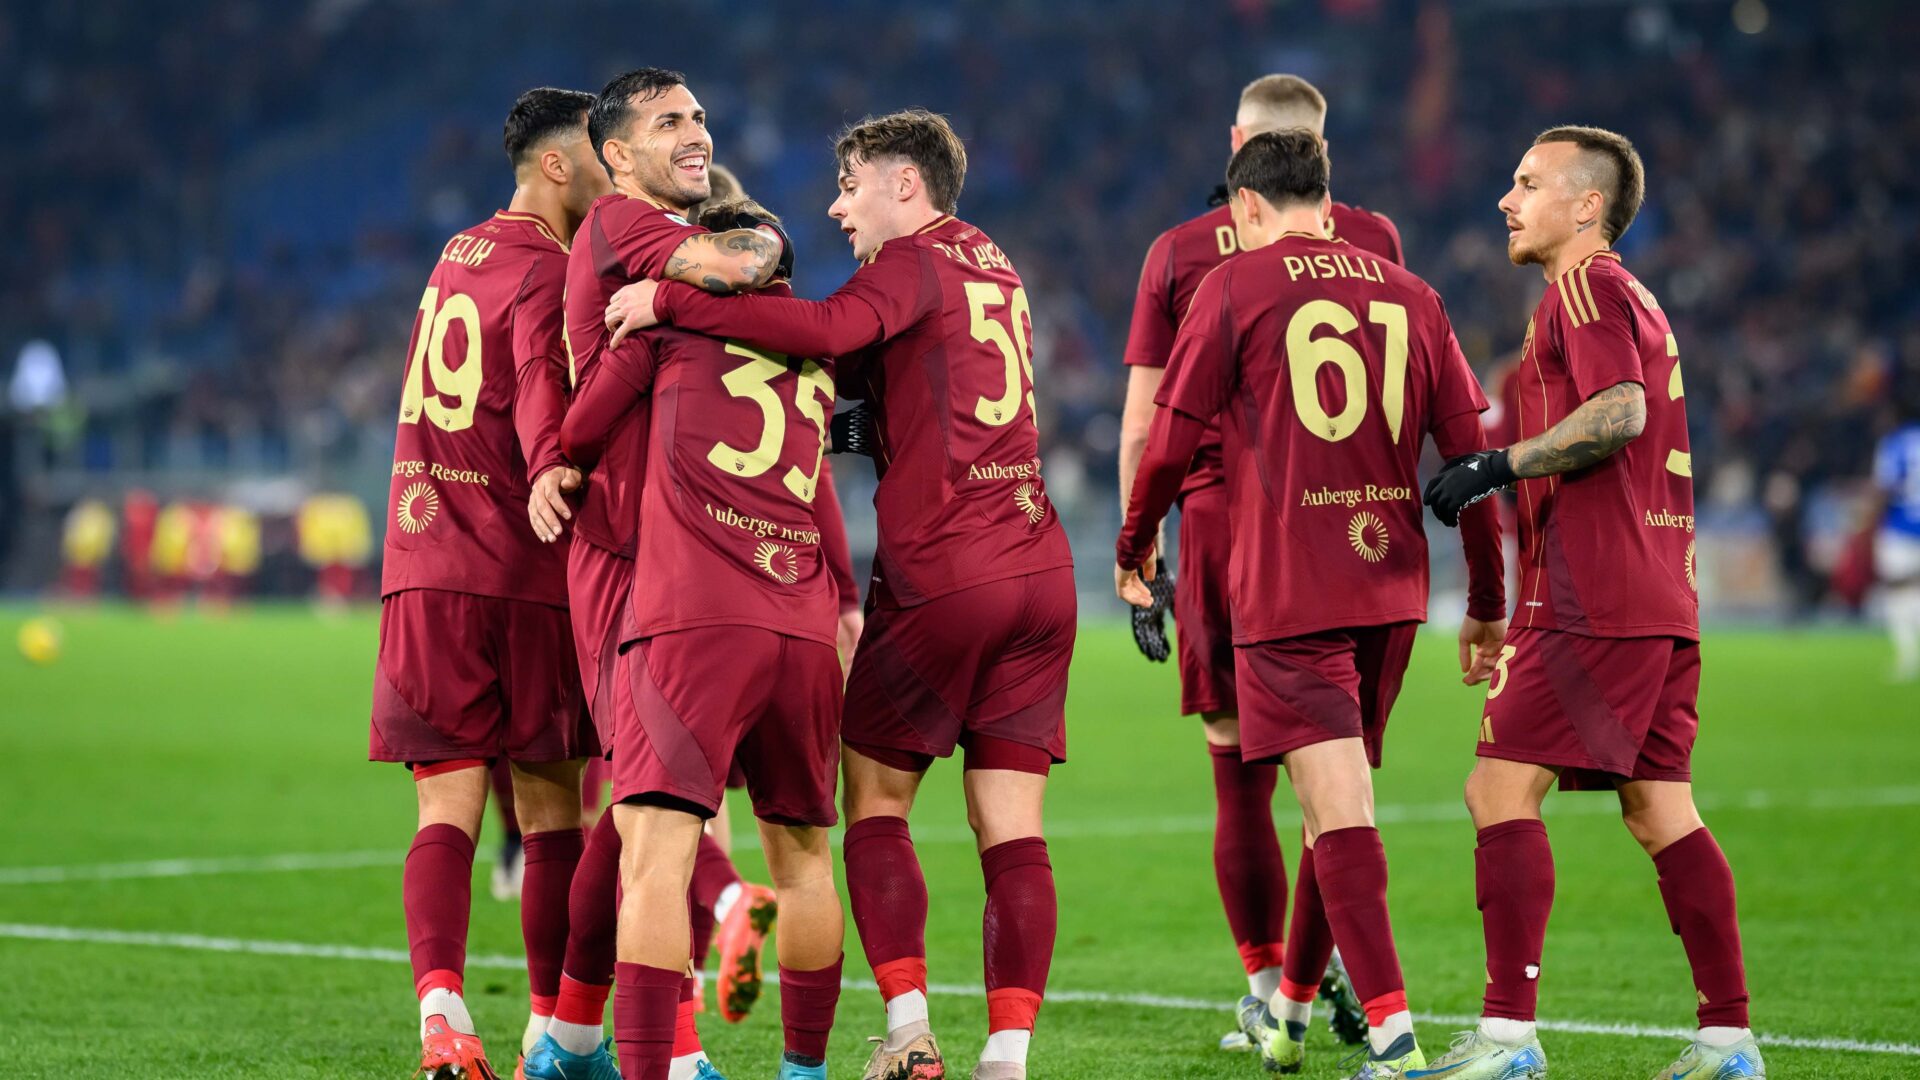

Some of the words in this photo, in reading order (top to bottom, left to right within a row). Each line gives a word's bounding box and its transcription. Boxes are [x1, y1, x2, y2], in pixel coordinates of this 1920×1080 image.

[1283, 254, 1385, 284] PISILLI
[399, 286, 483, 433] 19
[1286, 299, 1409, 445] 61
[707, 338, 835, 504] 35
[967, 461, 1034, 480] Auberge
[1300, 486, 1362, 508] Auberge
[1486, 644, 1517, 700] 3
